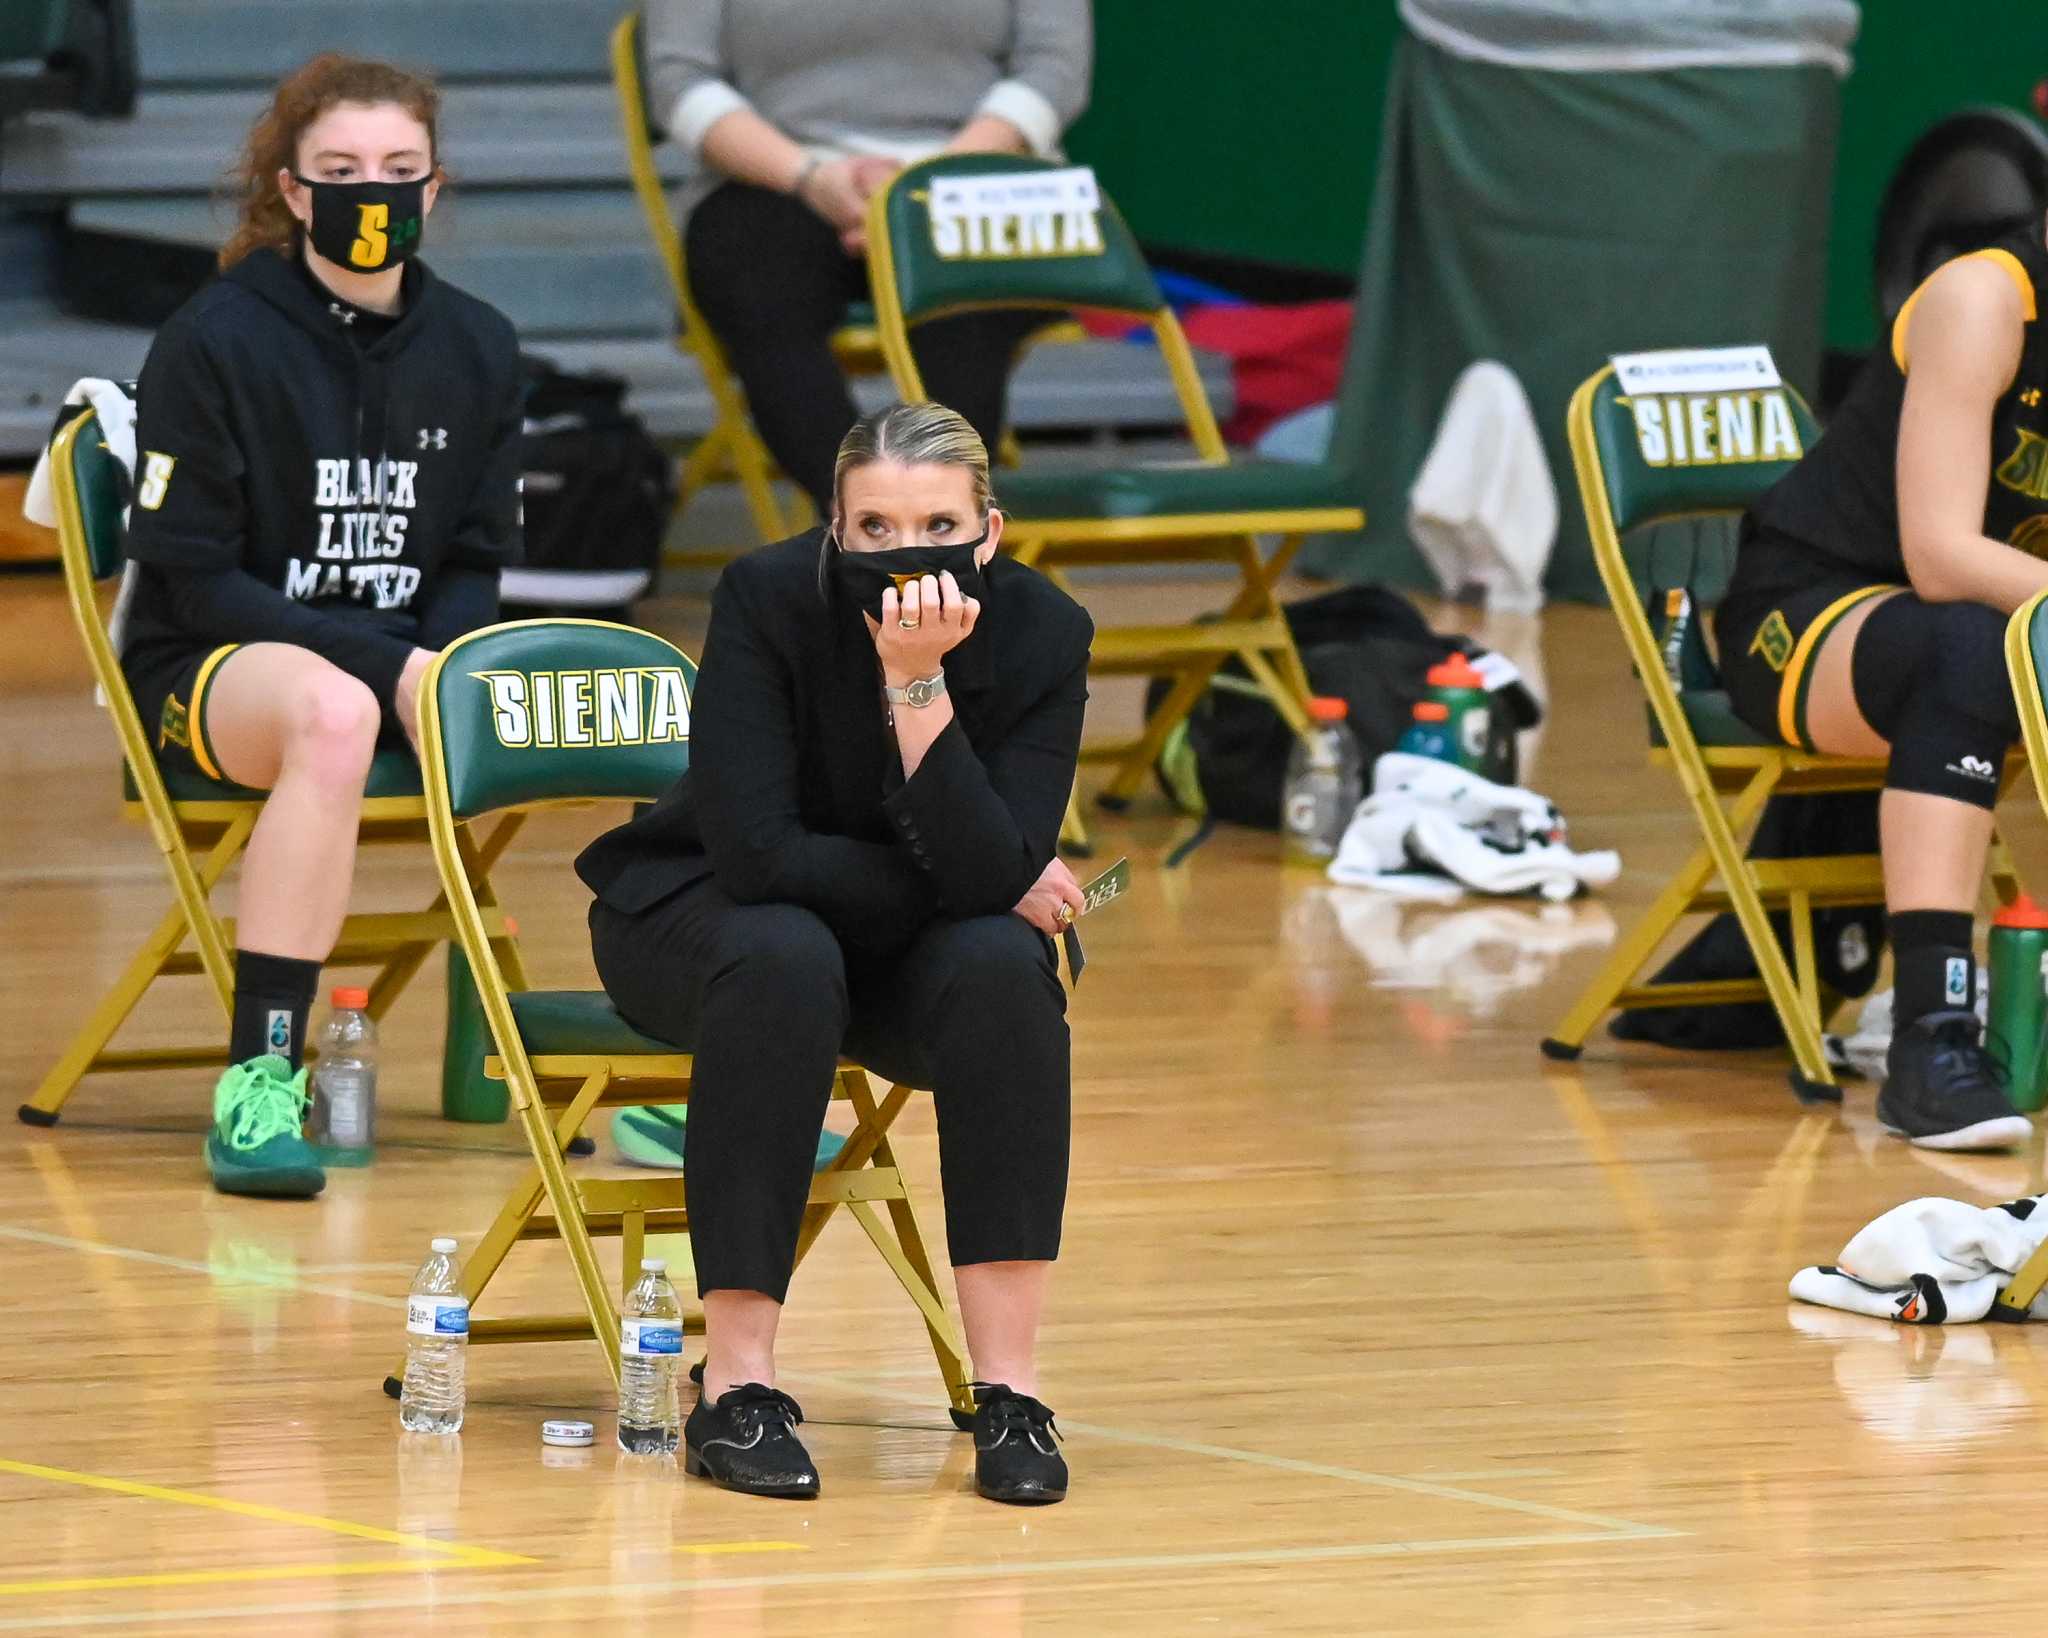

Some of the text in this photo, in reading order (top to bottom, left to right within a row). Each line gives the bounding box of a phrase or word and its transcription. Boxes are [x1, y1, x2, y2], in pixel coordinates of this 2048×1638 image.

[351, 203, 388, 268] S
[1615, 391, 1804, 468] SIENA
[139, 450, 178, 511] S
[314, 458, 418, 509] BLACK
[316, 512, 409, 560] LIVES
[284, 557, 422, 609] MATTER
[466, 666, 692, 749] SIENA
